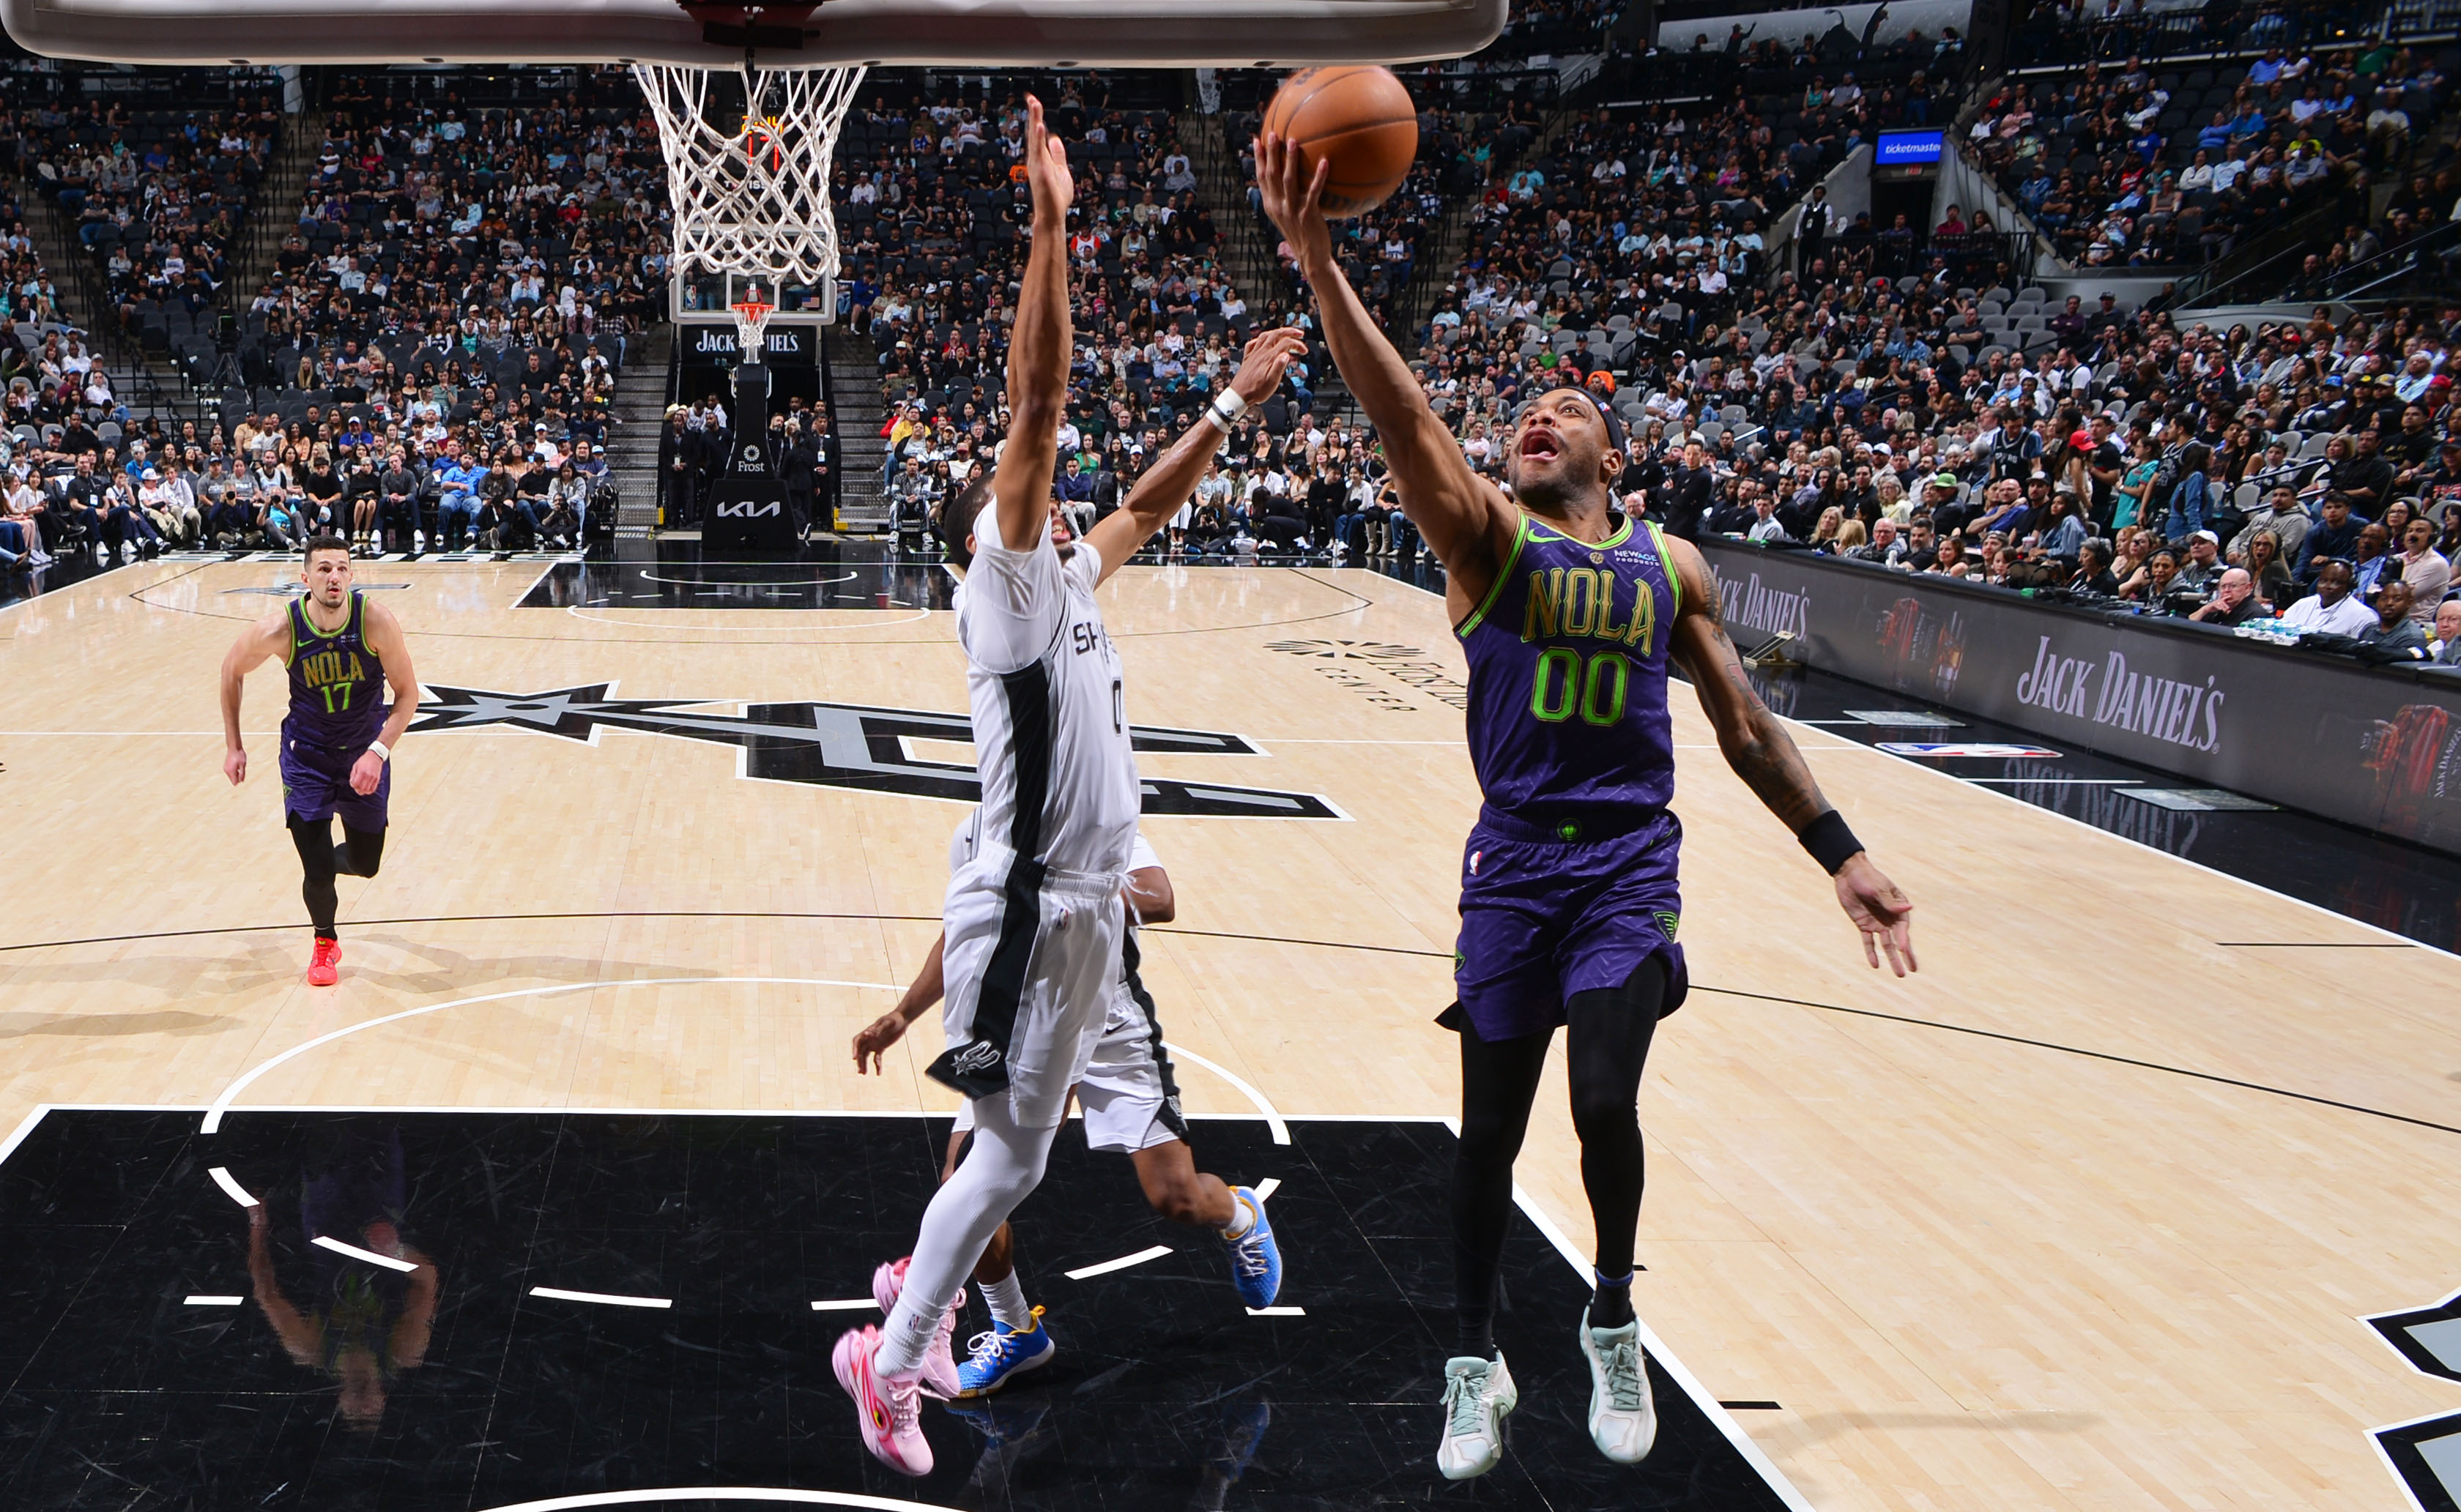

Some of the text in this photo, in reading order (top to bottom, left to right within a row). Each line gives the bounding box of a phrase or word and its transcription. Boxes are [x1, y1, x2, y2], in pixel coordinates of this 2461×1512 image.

[1885, 143, 1941, 154] ticketmaste
[749, 180, 787, 190] ISST
[696, 329, 799, 351] JACK IEL'S
[738, 461, 765, 472] Frost
[717, 501, 780, 517] KIA
[1615, 557, 1660, 567] PRODUCTS
[1521, 567, 1655, 656] NOLA
[1741, 573, 1811, 641] DANIEL'S
[302, 651, 365, 688] NOLA
[321, 682, 352, 713] 17
[1314, 667, 1418, 711] CENTER
[1529, 646, 1630, 726] 00
[2016, 636, 2096, 718] JACK
[2093, 651, 2224, 751] DANIEL'S
